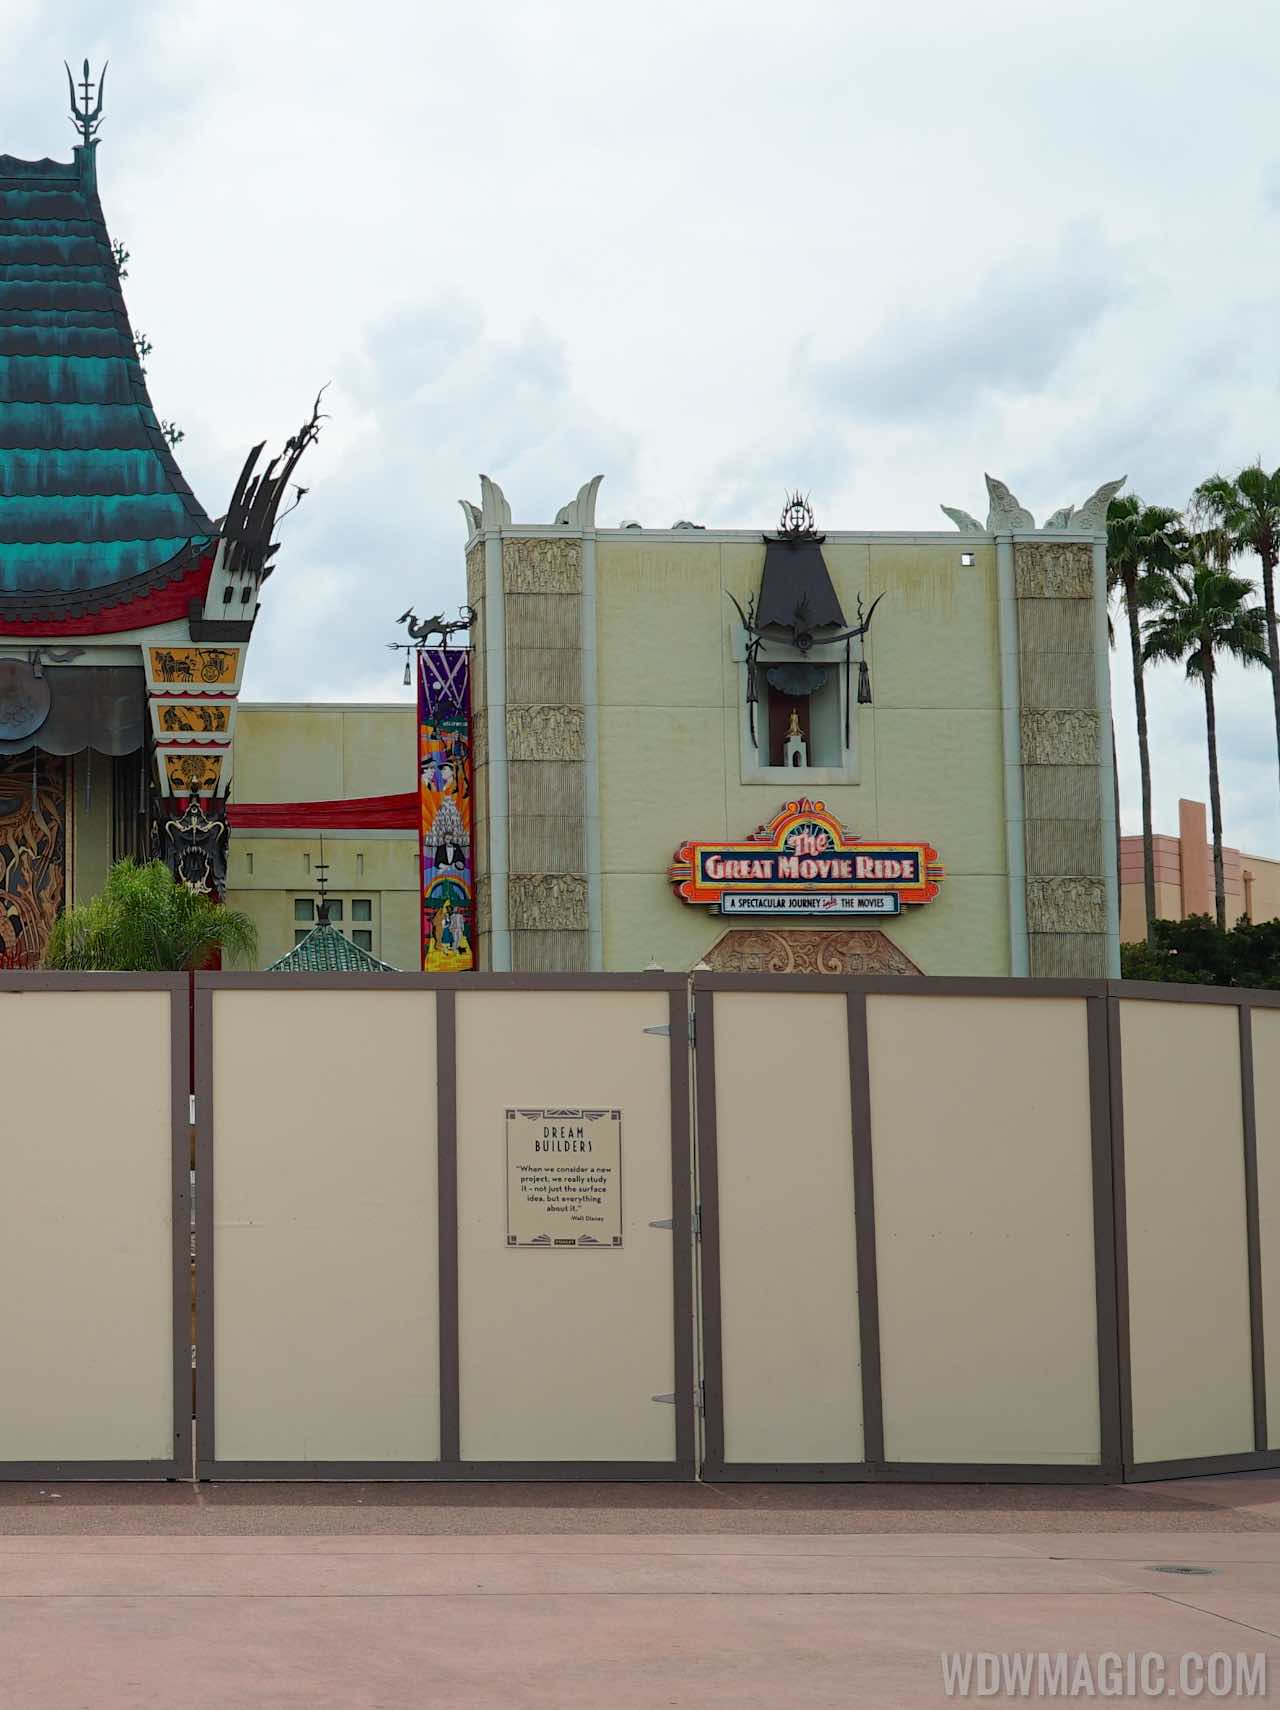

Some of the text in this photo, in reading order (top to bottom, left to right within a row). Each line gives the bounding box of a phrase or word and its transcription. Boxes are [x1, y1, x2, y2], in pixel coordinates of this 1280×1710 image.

[788, 829, 828, 856] The
[705, 855, 915, 880] GREAT MOVIE RIDE
[730, 898, 736, 907] A
[738, 898, 786, 908] SPECTACULAR
[788, 898, 820, 908] JOURNEY
[841, 898, 854, 908] THE
[857, 898, 885, 908] MOVIES
[543, 1126, 584, 1138] DREAM
[535, 1140, 592, 1152] BUILDERS
[564, 1176, 584, 1184] really
[587, 1176, 607, 1184] study
[561, 1196, 602, 1204] everything
